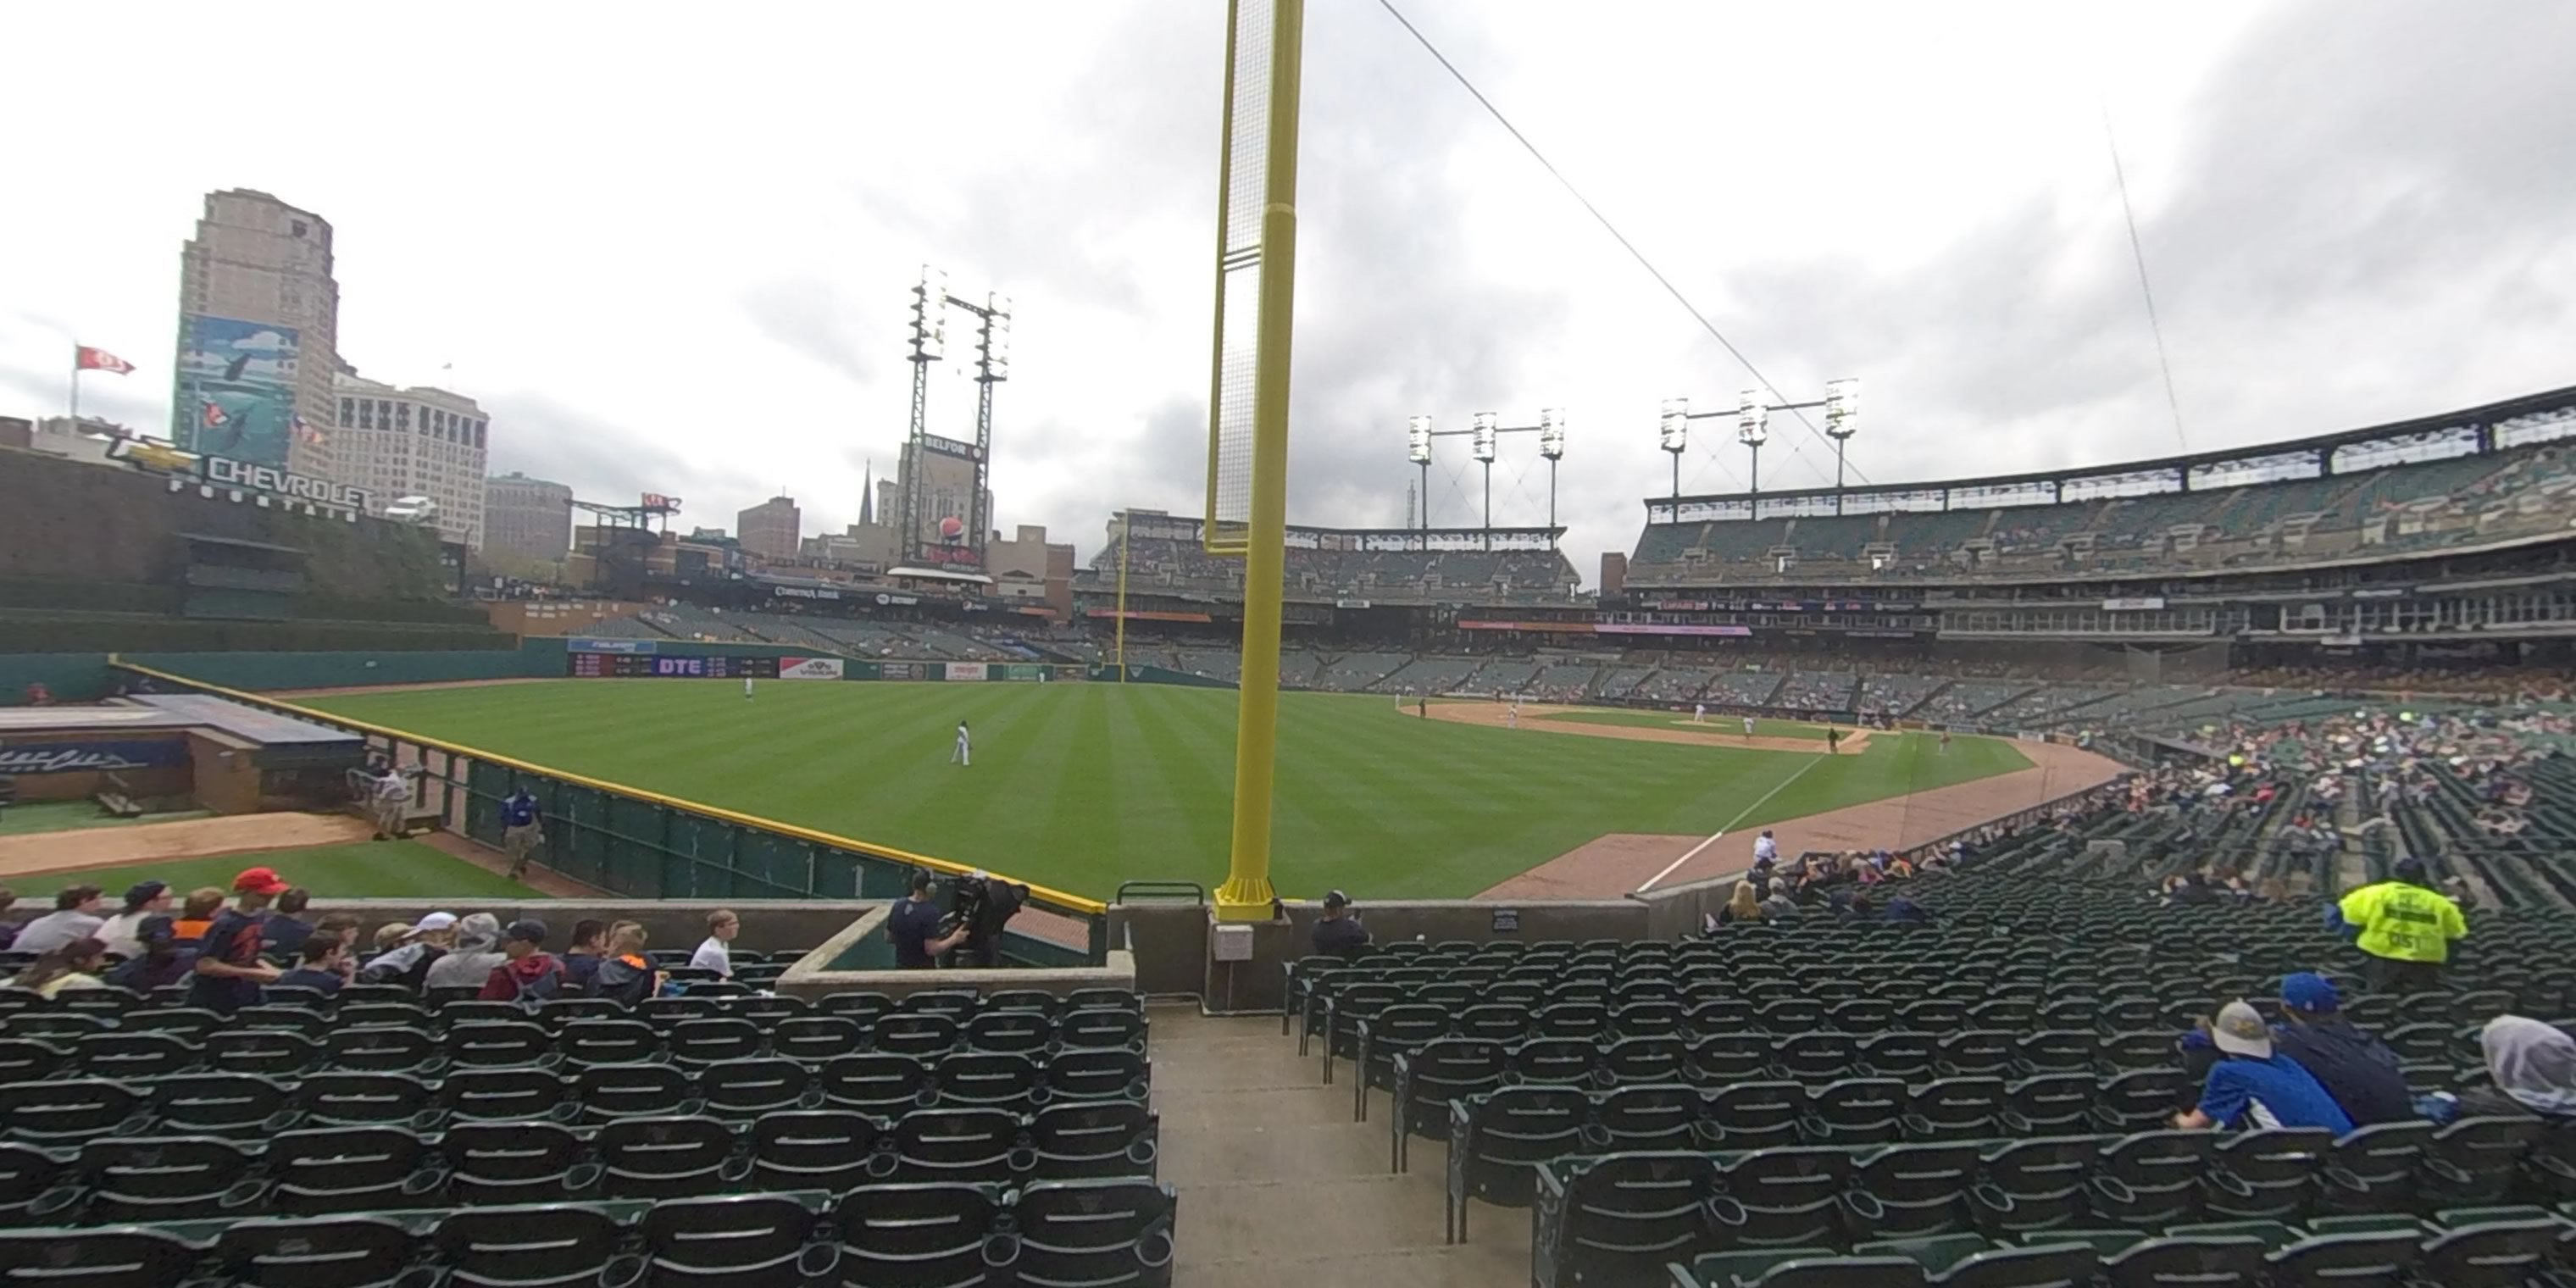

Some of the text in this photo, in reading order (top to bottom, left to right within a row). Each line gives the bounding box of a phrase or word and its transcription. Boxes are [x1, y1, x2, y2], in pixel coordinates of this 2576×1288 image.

[925, 436, 967, 455] BELFOR
[208, 456, 374, 517] CHEVROLET
[659, 658, 702, 675] DTE
